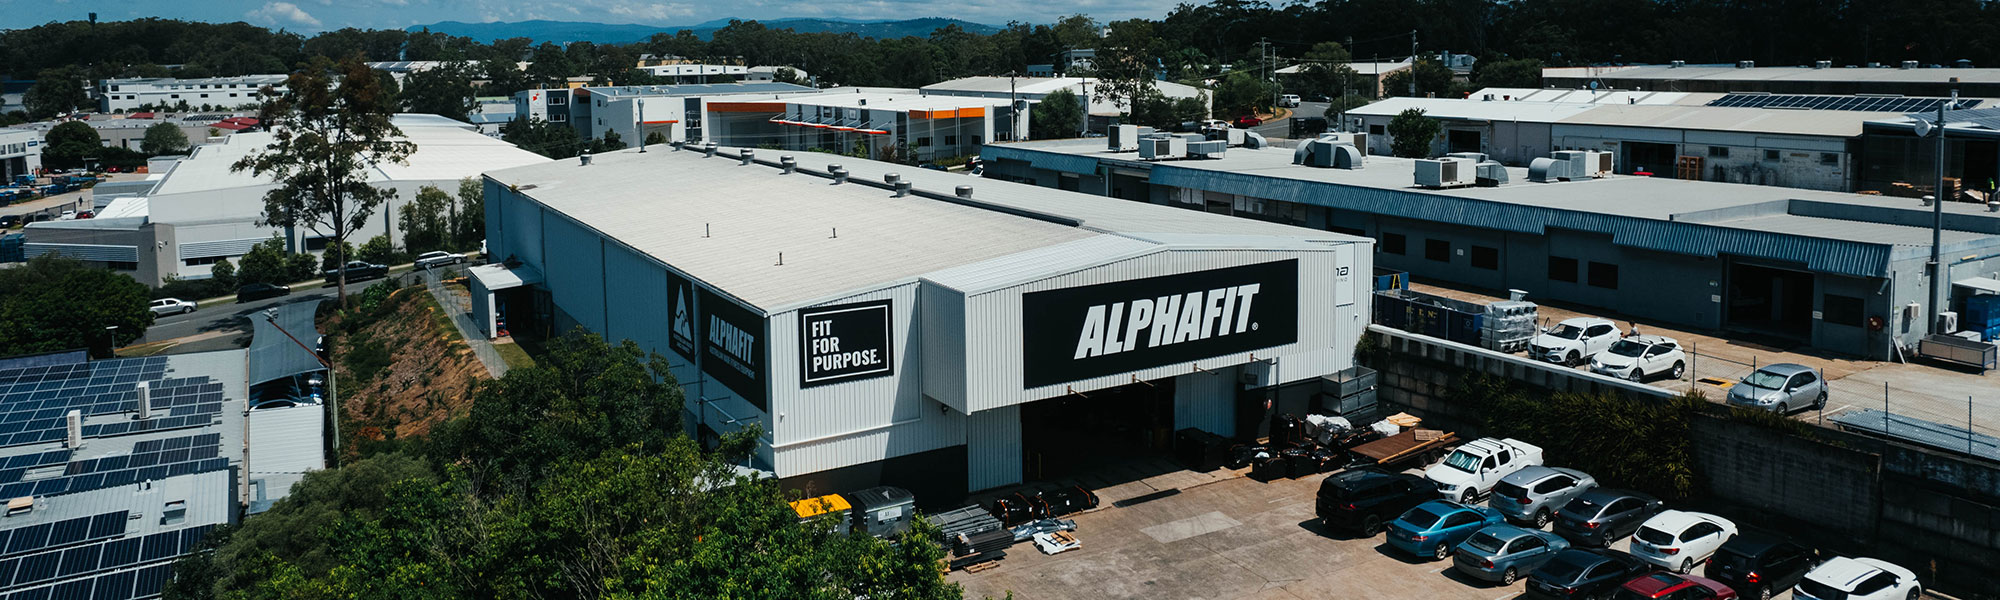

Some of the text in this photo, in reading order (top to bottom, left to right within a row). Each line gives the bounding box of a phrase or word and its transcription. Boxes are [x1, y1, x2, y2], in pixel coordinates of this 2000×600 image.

[812, 319, 833, 338] FIT
[709, 314, 755, 365] ALPHAFIT
[813, 337, 840, 356] FOR
[813, 348, 881, 372] PURPOSE.
